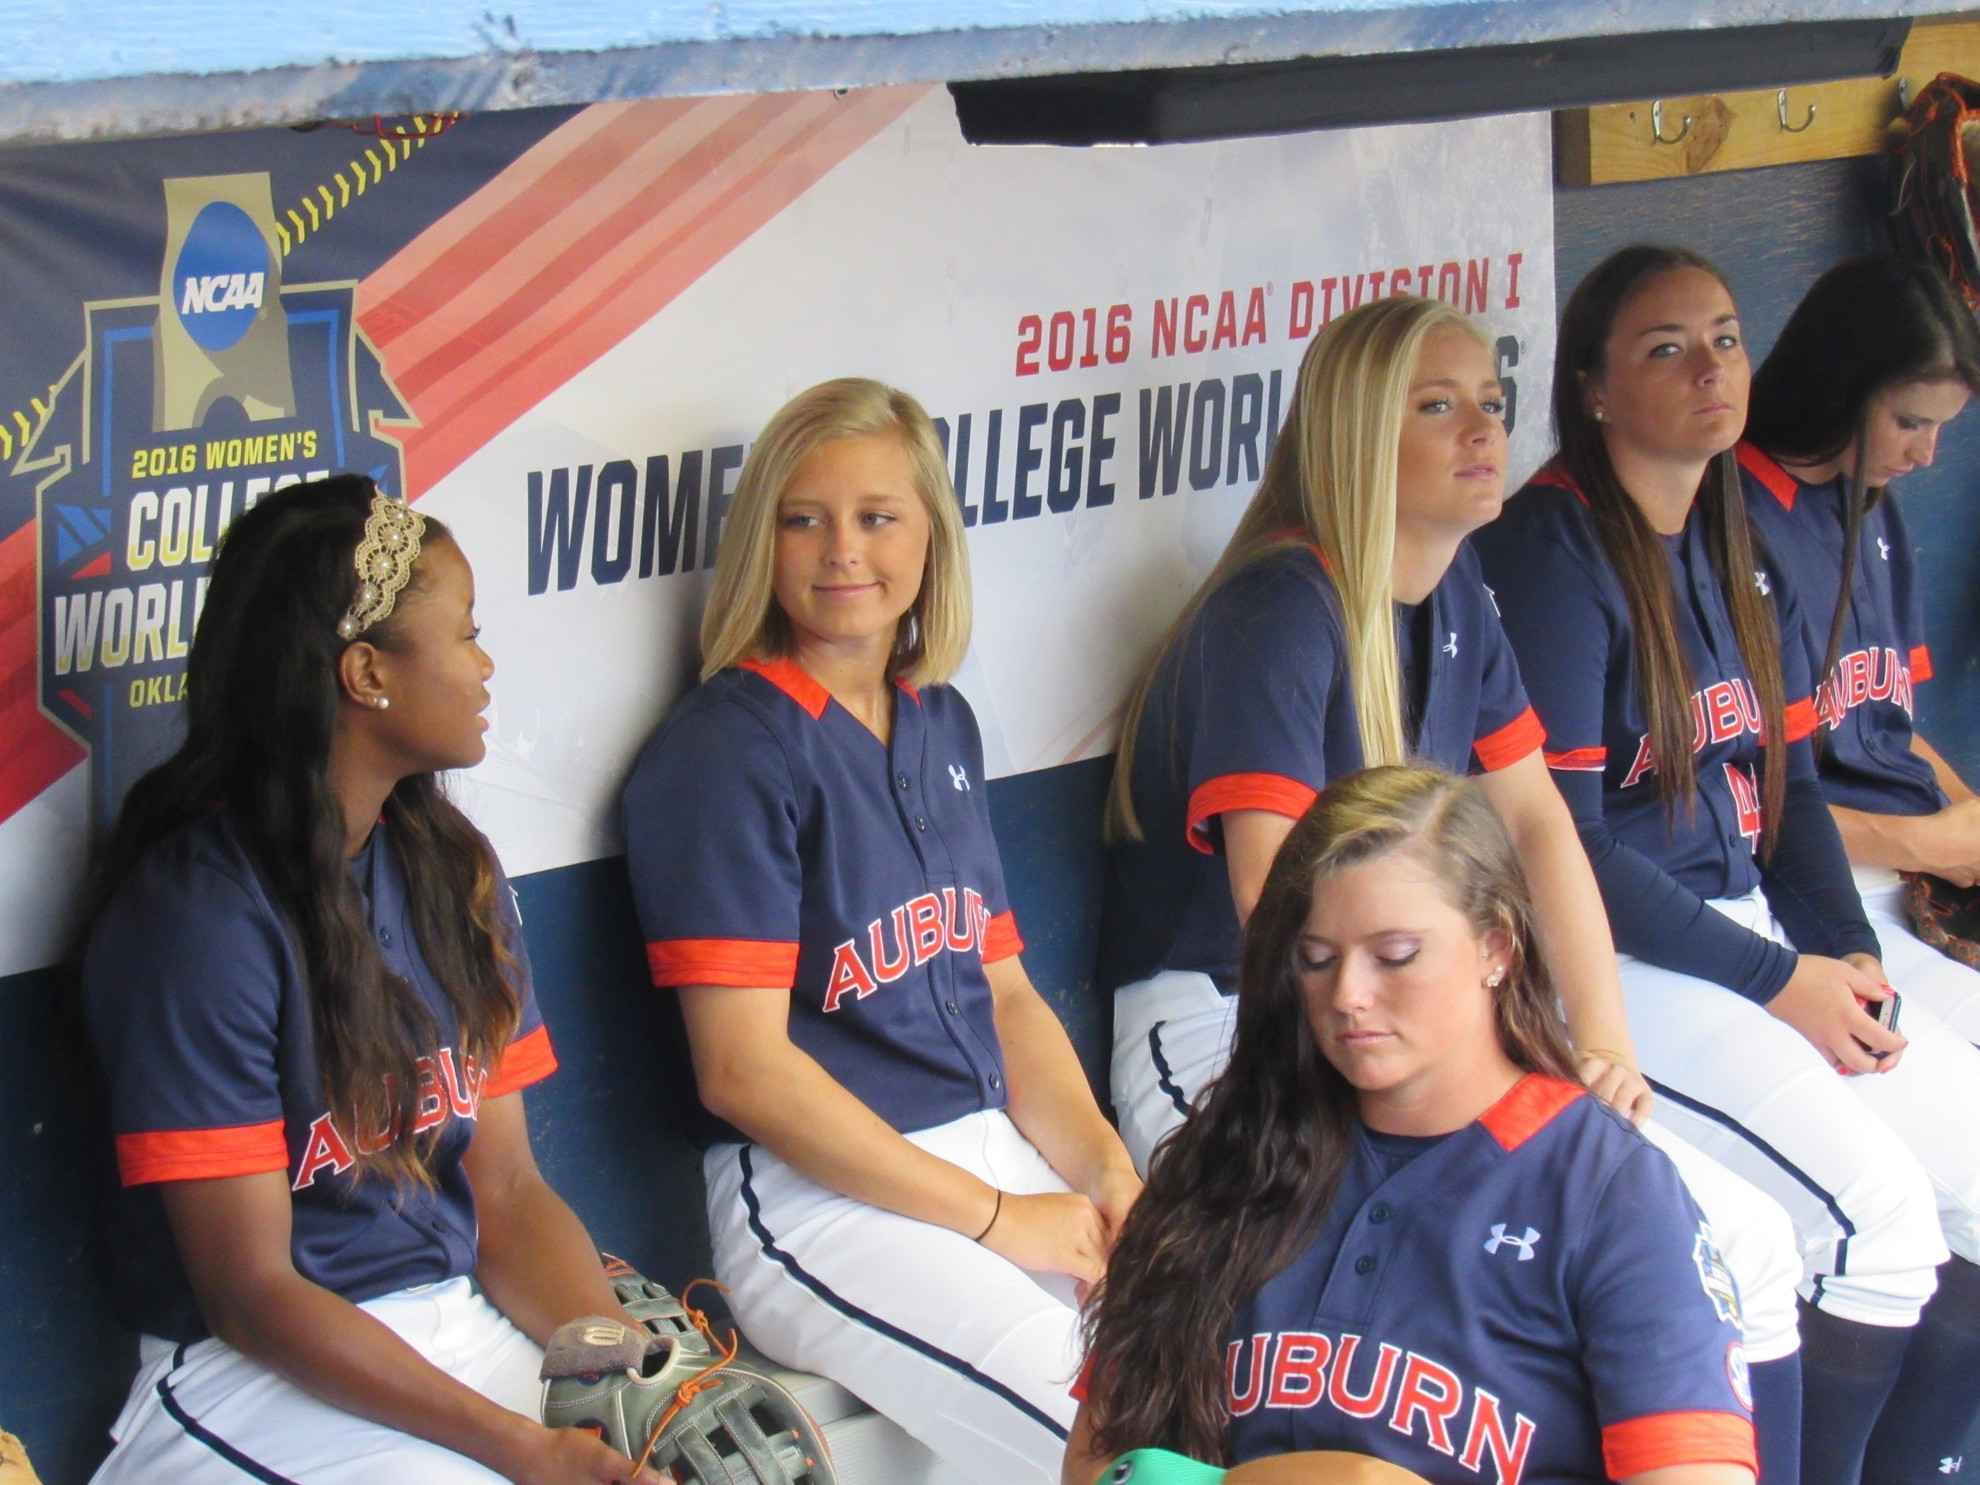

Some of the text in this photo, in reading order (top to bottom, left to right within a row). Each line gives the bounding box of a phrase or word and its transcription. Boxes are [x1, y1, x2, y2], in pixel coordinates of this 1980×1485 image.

[181, 272, 264, 315] NCAA
[1015, 304, 1132, 377] 2016
[1504, 253, 1523, 309] I
[131, 430, 318, 479] 2016 WOMEN'S
[527, 443, 755, 597] WOME
[1138, 366, 1301, 501] WORL
[1219, 1331, 1536, 1485] UBURN
